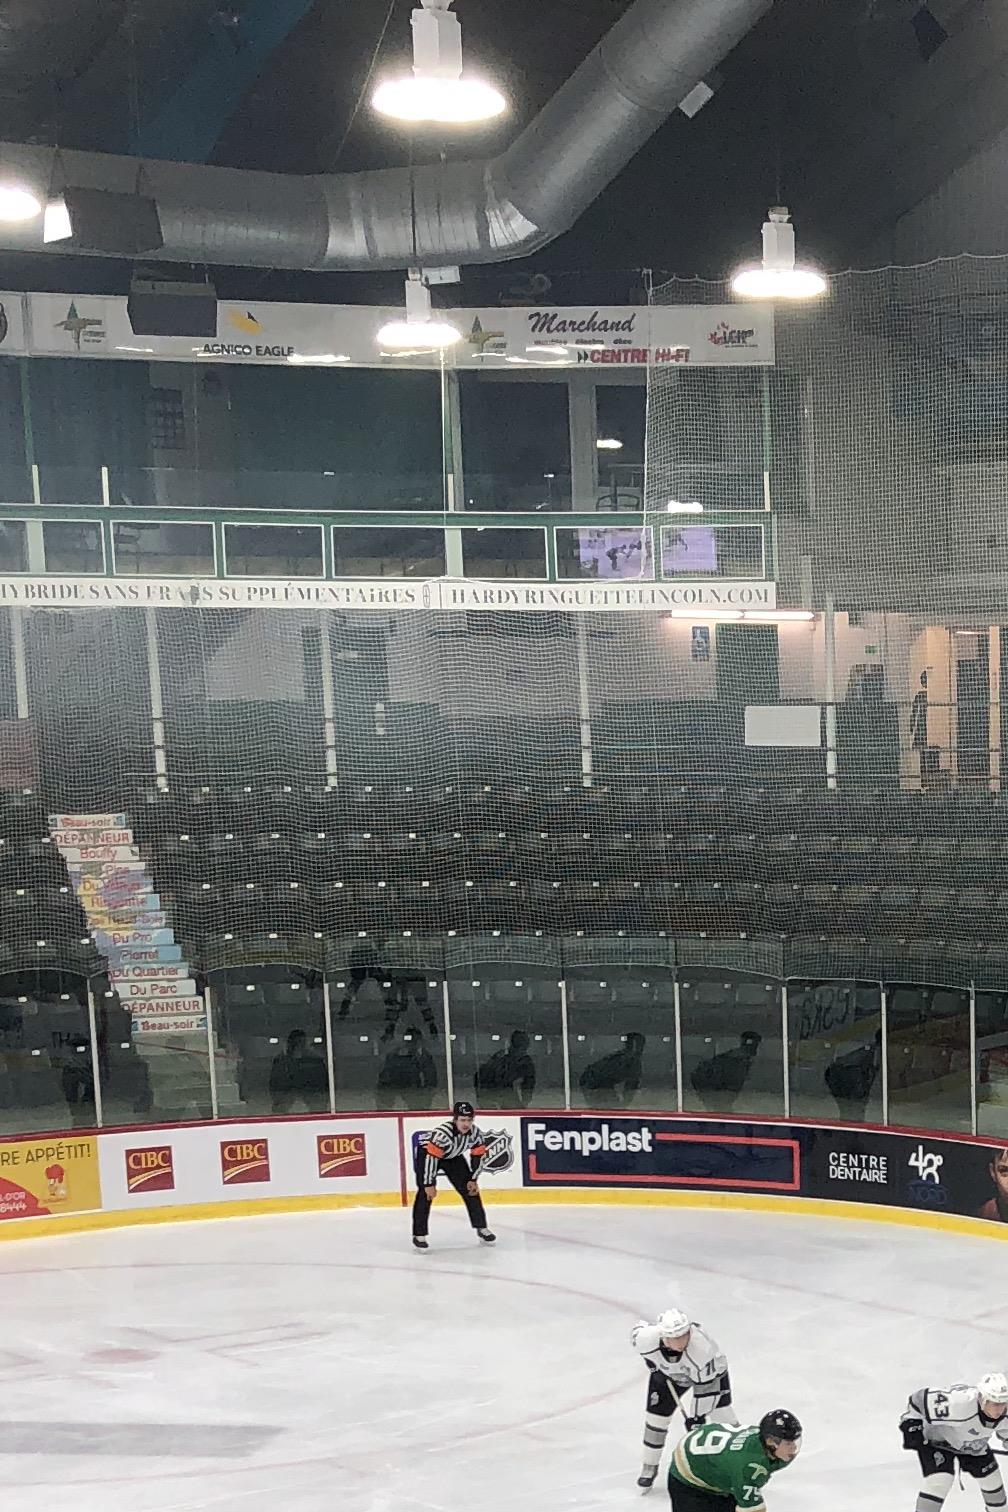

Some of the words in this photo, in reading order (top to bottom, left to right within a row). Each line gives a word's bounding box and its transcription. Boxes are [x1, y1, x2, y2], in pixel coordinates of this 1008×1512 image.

[528, 310, 637, 334] Marchand
[203, 343, 251, 357] AGNICO
[255, 345, 295, 357] EAGLE
[589, 348, 650, 364] CENTRE
[89, 584, 139, 600] SANS
[218, 582, 416, 603] SUPPLÉMENTAIRES
[452, 587, 769, 605] HARDYRINGUETTELINCOLN.COM
[54, 832, 130, 845] DÉPANNEUR
[132, 965, 179, 977] Quartier
[130, 985, 147, 996] Du
[151, 984, 178, 995] Parc
[121, 1000, 200, 1013] DÉPANNEUR
[141, 1019, 195, 1031] Beau-soir
[320, 1137, 363, 1155] CIBC
[527, 1122, 653, 1156] Fenplast
[25, 1141, 91, 1164] APPÉTIT!
[128, 1150, 171, 1169] CIBC
[223, 1144, 266, 1162] CIBC
[828, 1152, 888, 1170] CENTRE
[829, 1166, 888, 1184] DENTAIRE
[934, 1393, 949, 1418] 43
